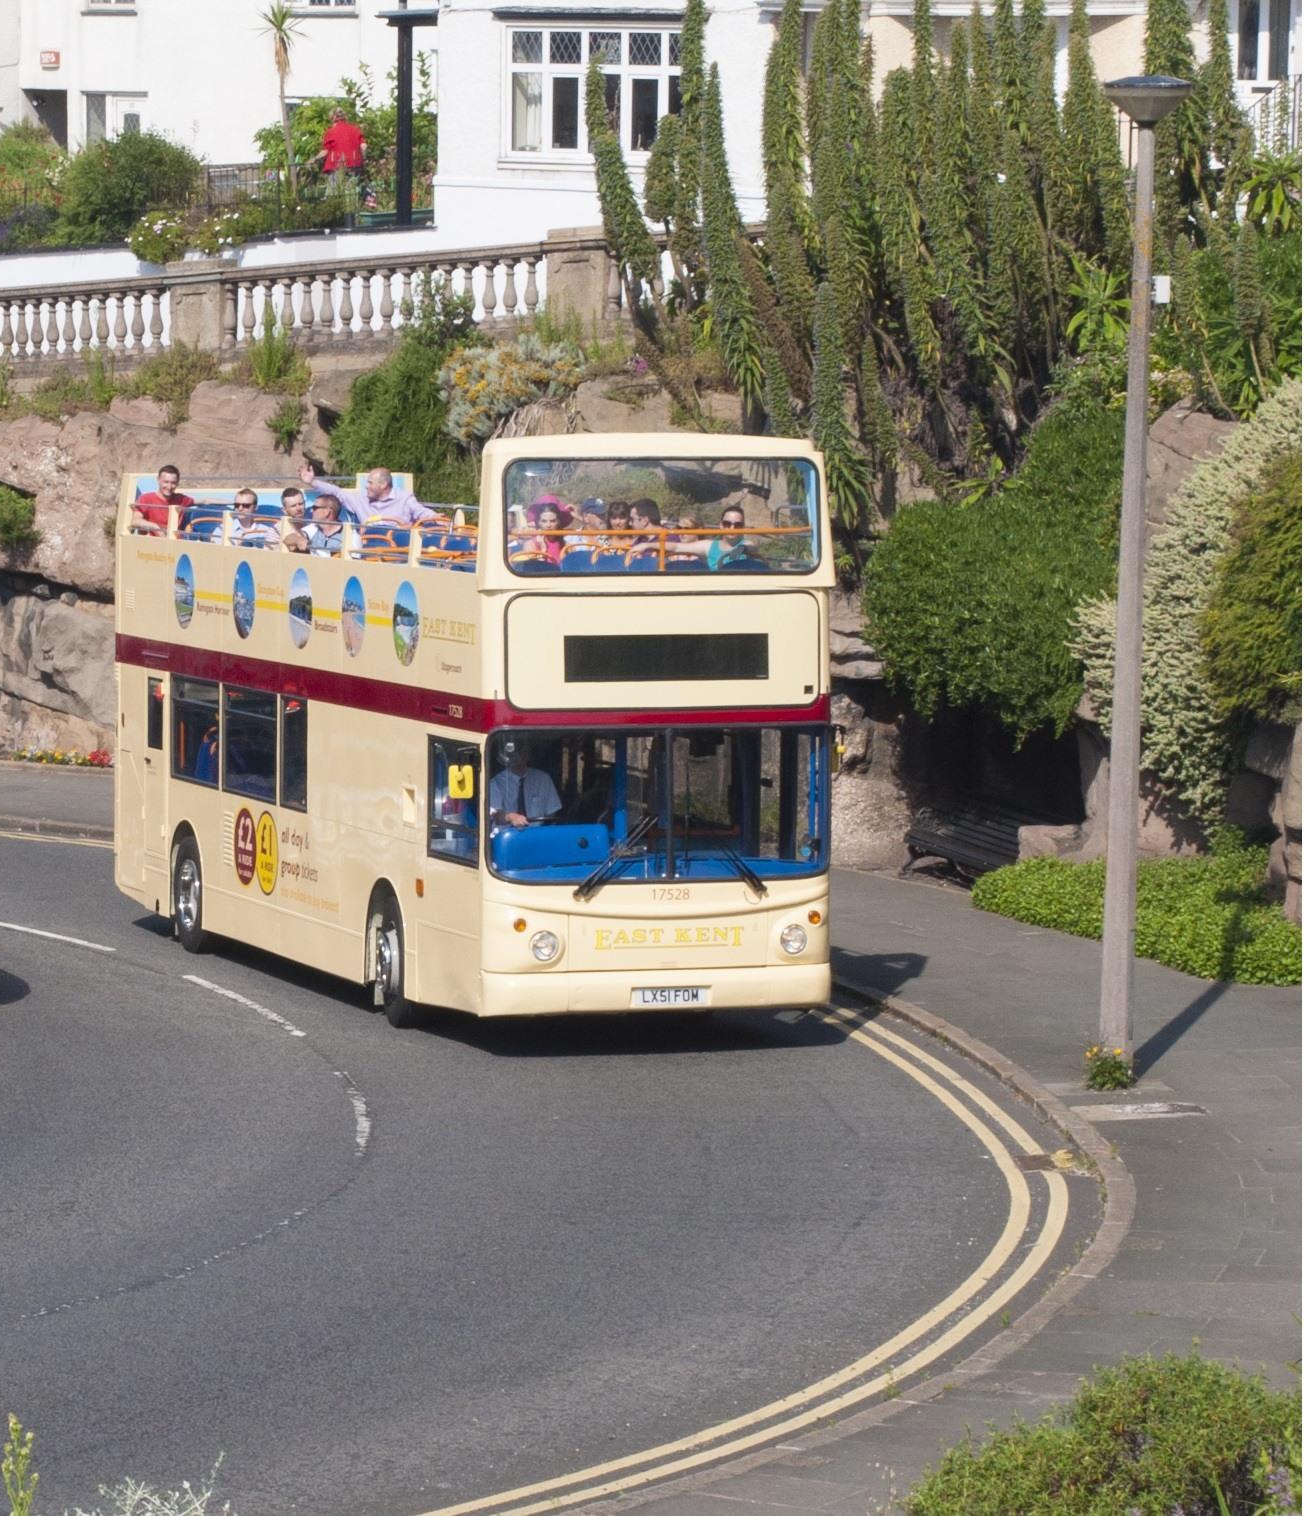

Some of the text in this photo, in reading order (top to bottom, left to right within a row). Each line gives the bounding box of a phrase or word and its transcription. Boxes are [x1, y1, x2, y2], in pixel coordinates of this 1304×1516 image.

[422, 616, 476, 645] EAST KENT
[238, 816, 253, 851] £2
[260, 823, 272, 857] £1
[281, 827, 290, 844] all
[291, 828, 303, 853] day
[280, 860, 318, 883] group tickets
[652, 888, 690, 901] 17528
[594, 926, 745, 951] EAST KENT
